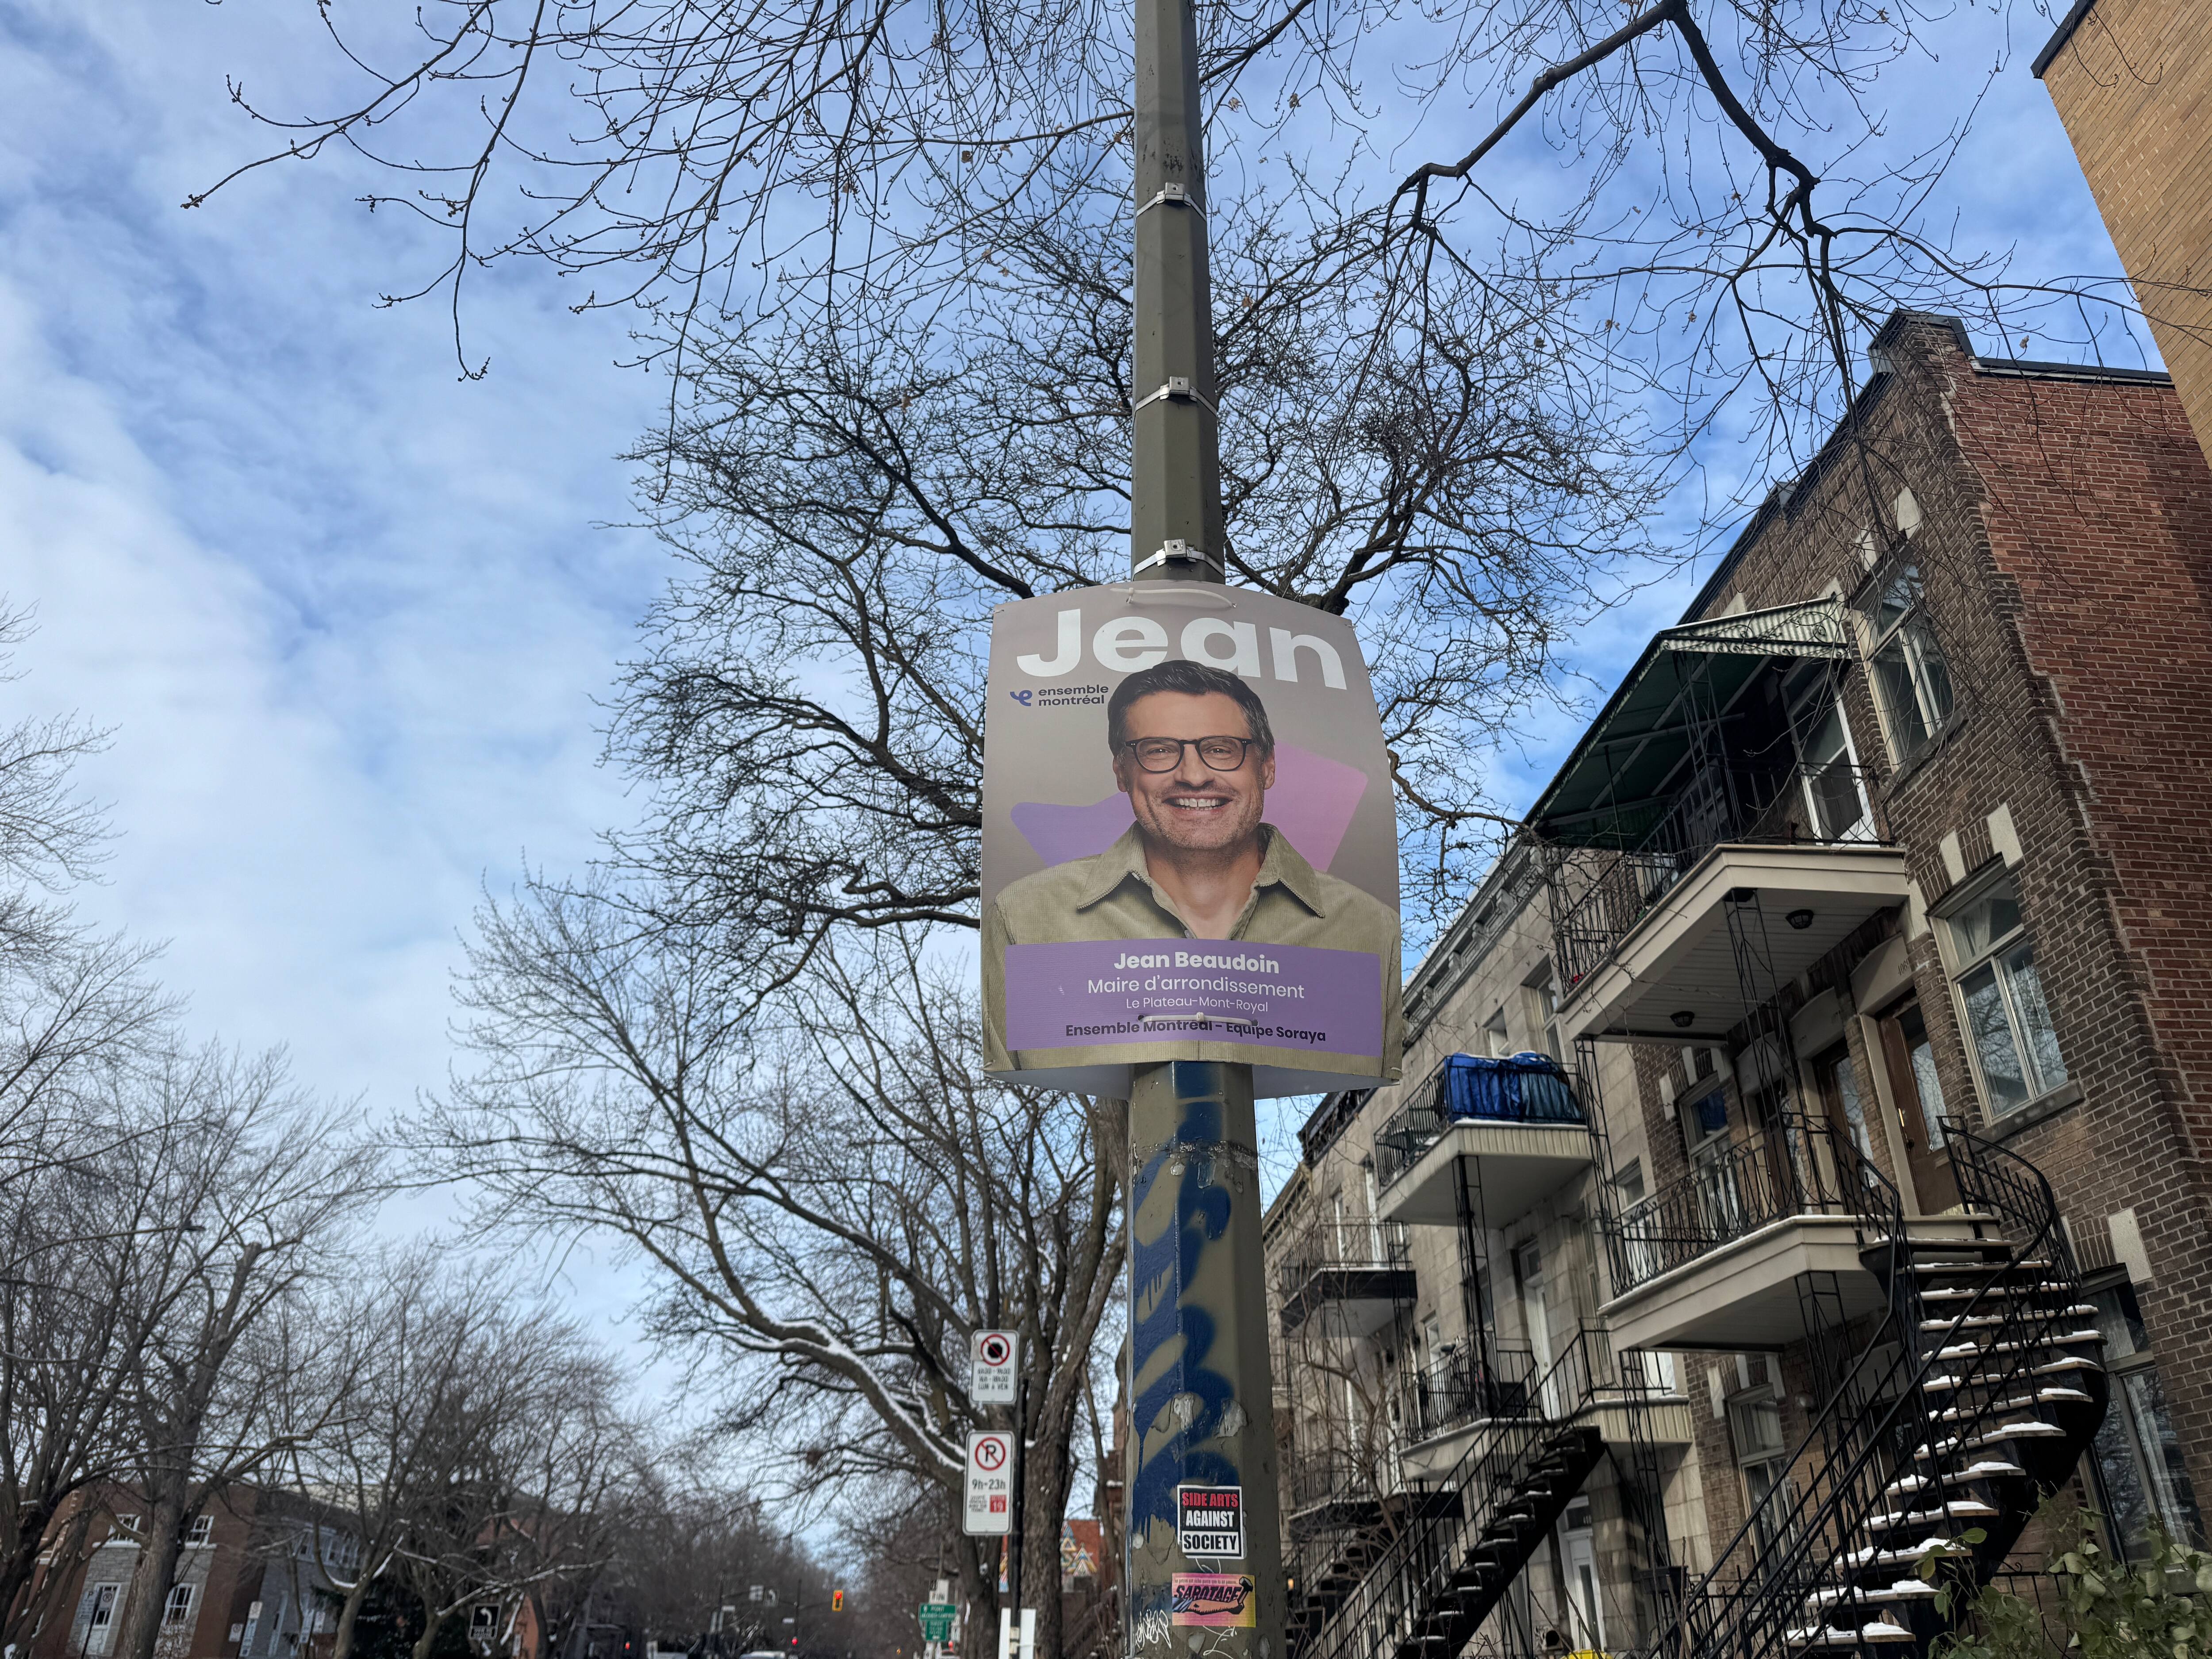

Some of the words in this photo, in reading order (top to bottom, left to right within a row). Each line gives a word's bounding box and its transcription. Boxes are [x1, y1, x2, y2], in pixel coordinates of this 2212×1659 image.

[1017, 609, 1347, 690] Jean
[1038, 684, 1109, 696] ensemble
[1038, 695, 1104, 706] montréal
[1114, 953, 1170, 969] Jean
[1175, 952, 1279, 973] Beaudoin
[1088, 977, 1140, 993] Maire
[1144, 975, 1305, 998] d'arrondissement
[1126, 998, 1139, 1008] Le
[1143, 996, 1268, 1014] Plateau-Mont-Royal
[1066, 1022, 1140, 1036] Ensemble
[1276, 1026, 1326, 1044] Soraya
[1182, 1492, 1207, 1506] SIDE
[1209, 1493, 1239, 1508] ARTS
[1186, 1510, 1234, 1527] AGAINST
[1183, 1534, 1237, 1550] SOCIETY
